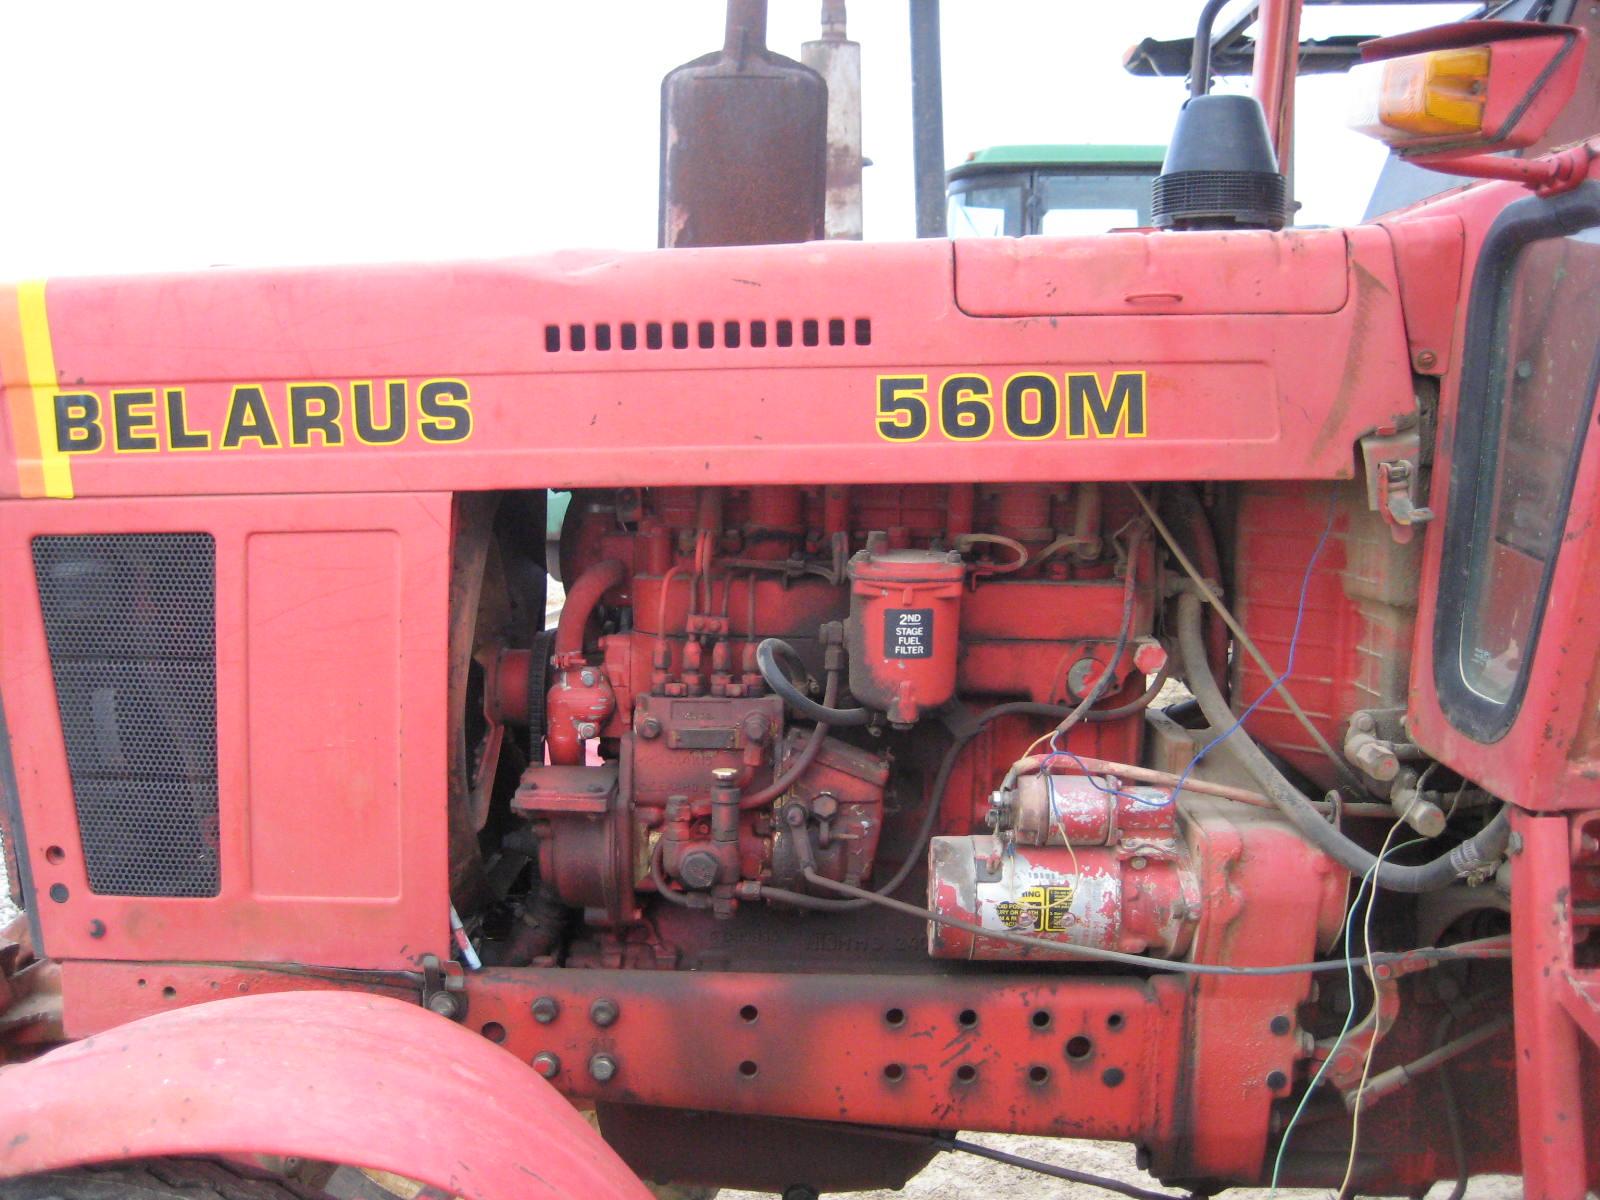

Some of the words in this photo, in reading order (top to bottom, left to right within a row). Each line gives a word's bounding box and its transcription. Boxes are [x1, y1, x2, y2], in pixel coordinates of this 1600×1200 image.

[876, 371, 1147, 442] 560M
[54, 378, 472, 454] BELARUS
[899, 613, 921, 625] 2ND
[895, 627, 924, 636] STAGE
[898, 636, 921, 645] FUEL
[895, 646, 924, 654] FILTER
